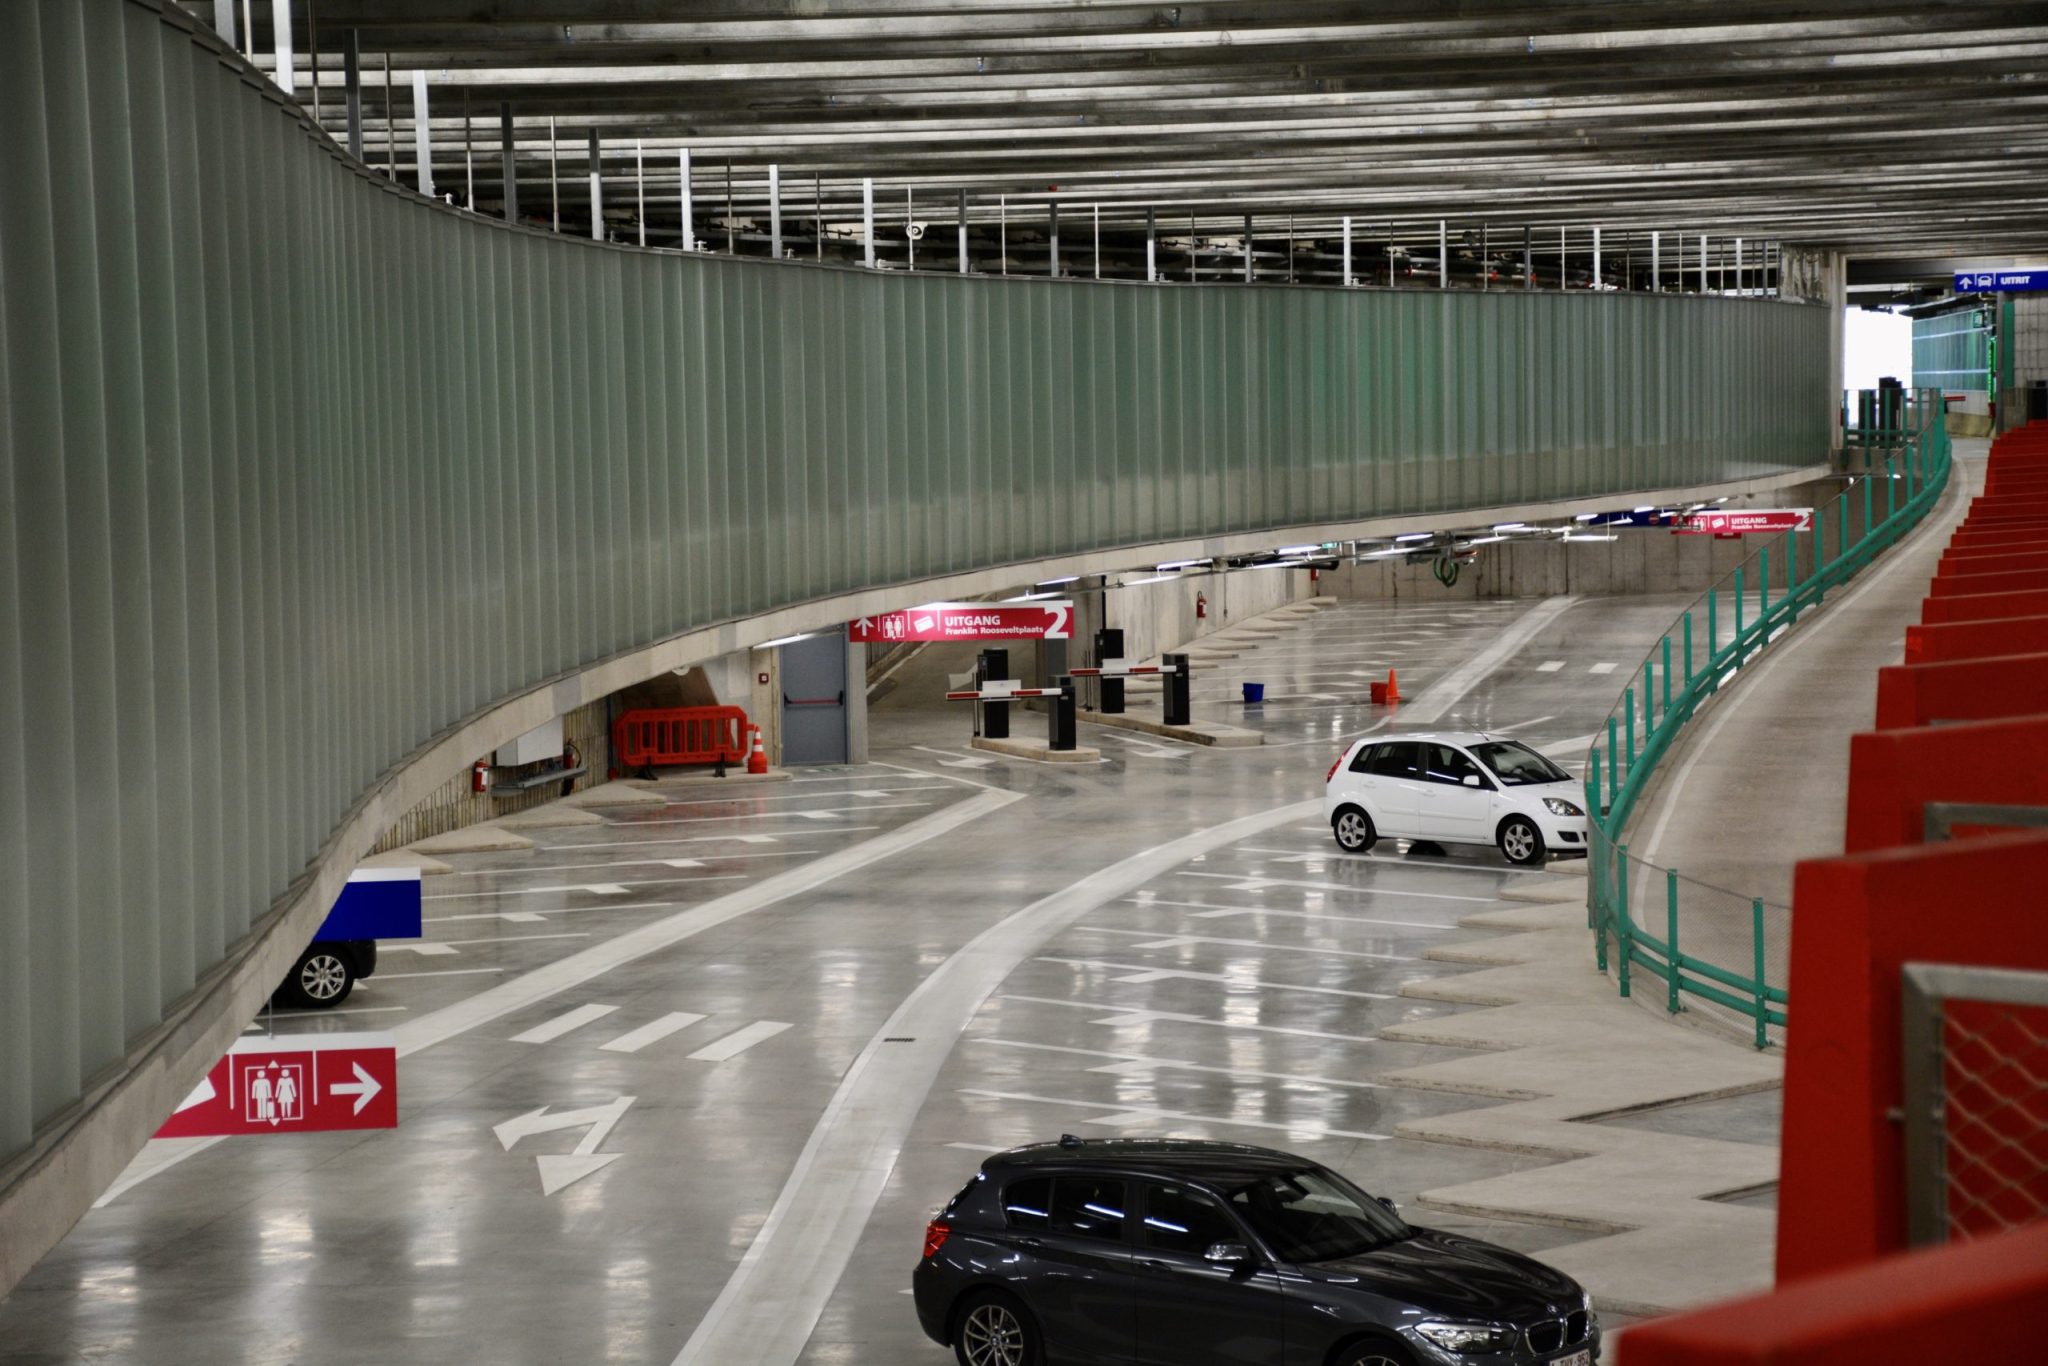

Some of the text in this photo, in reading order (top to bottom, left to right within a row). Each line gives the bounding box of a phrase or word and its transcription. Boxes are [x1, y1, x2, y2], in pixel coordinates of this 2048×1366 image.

[2000, 276, 2031, 285] UITRIT
[1794, 509, 1811, 531] 2
[944, 615, 1001, 627] UITGANG
[1044, 603, 1069, 639] 2
[945, 626, 1043, 635] Franklin Rooseveltplaats
